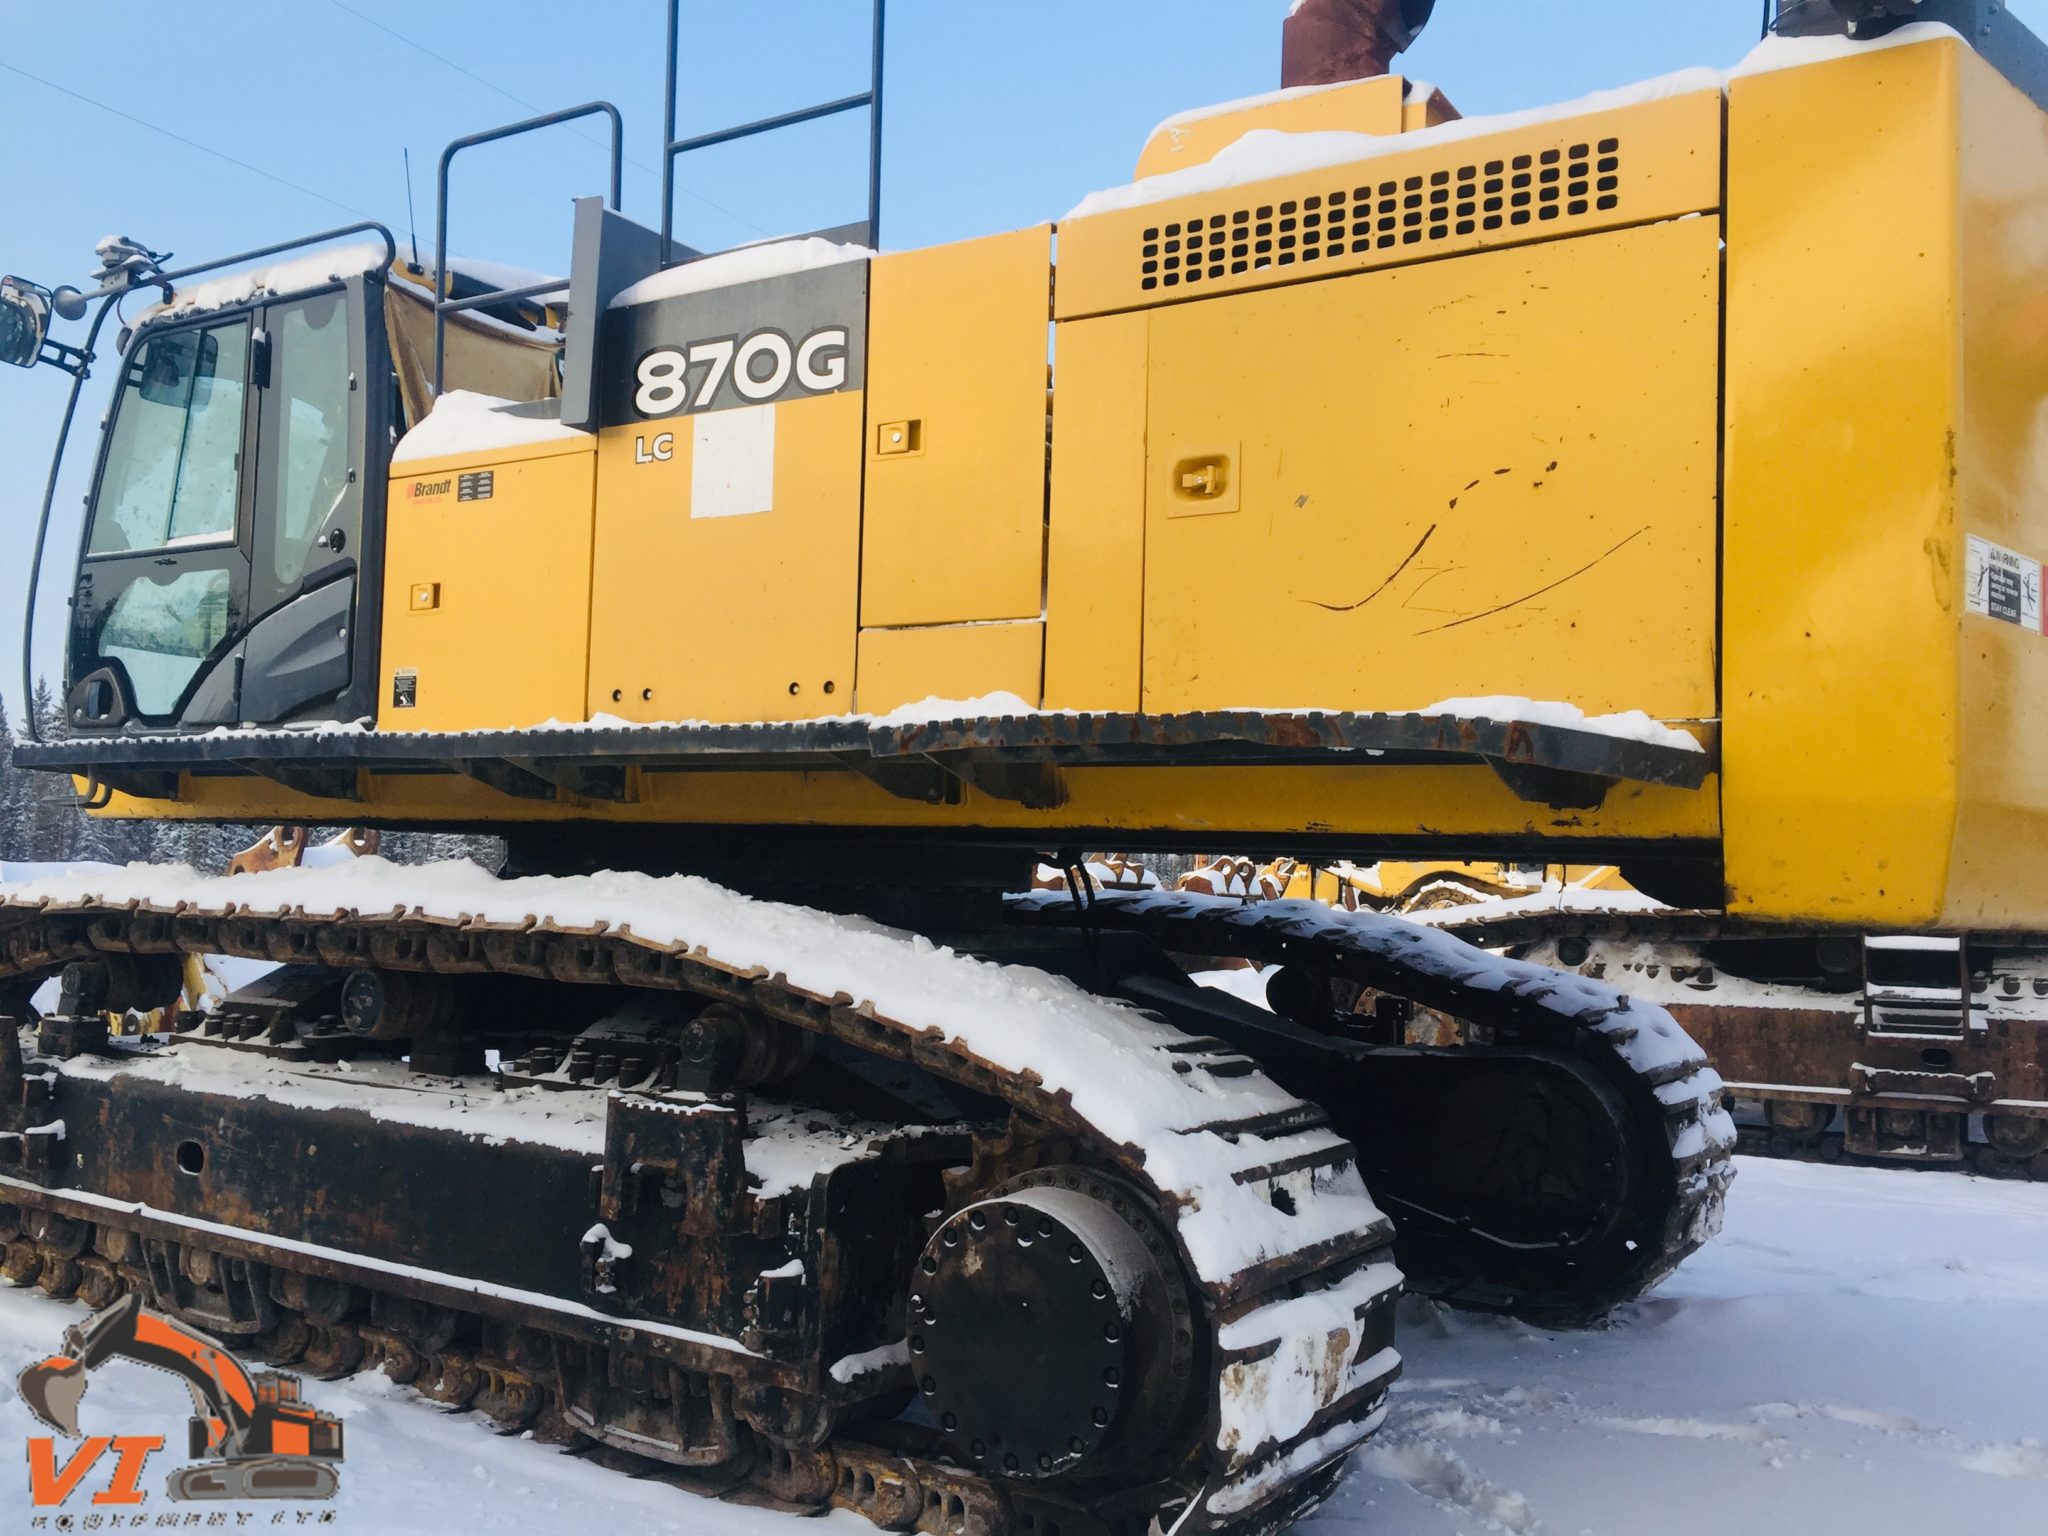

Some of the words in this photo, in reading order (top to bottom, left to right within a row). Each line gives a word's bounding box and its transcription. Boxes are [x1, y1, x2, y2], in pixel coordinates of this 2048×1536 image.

[635, 329, 847, 416] 870G
[635, 433, 674, 464] LC
[413, 479, 452, 497] Brandt
